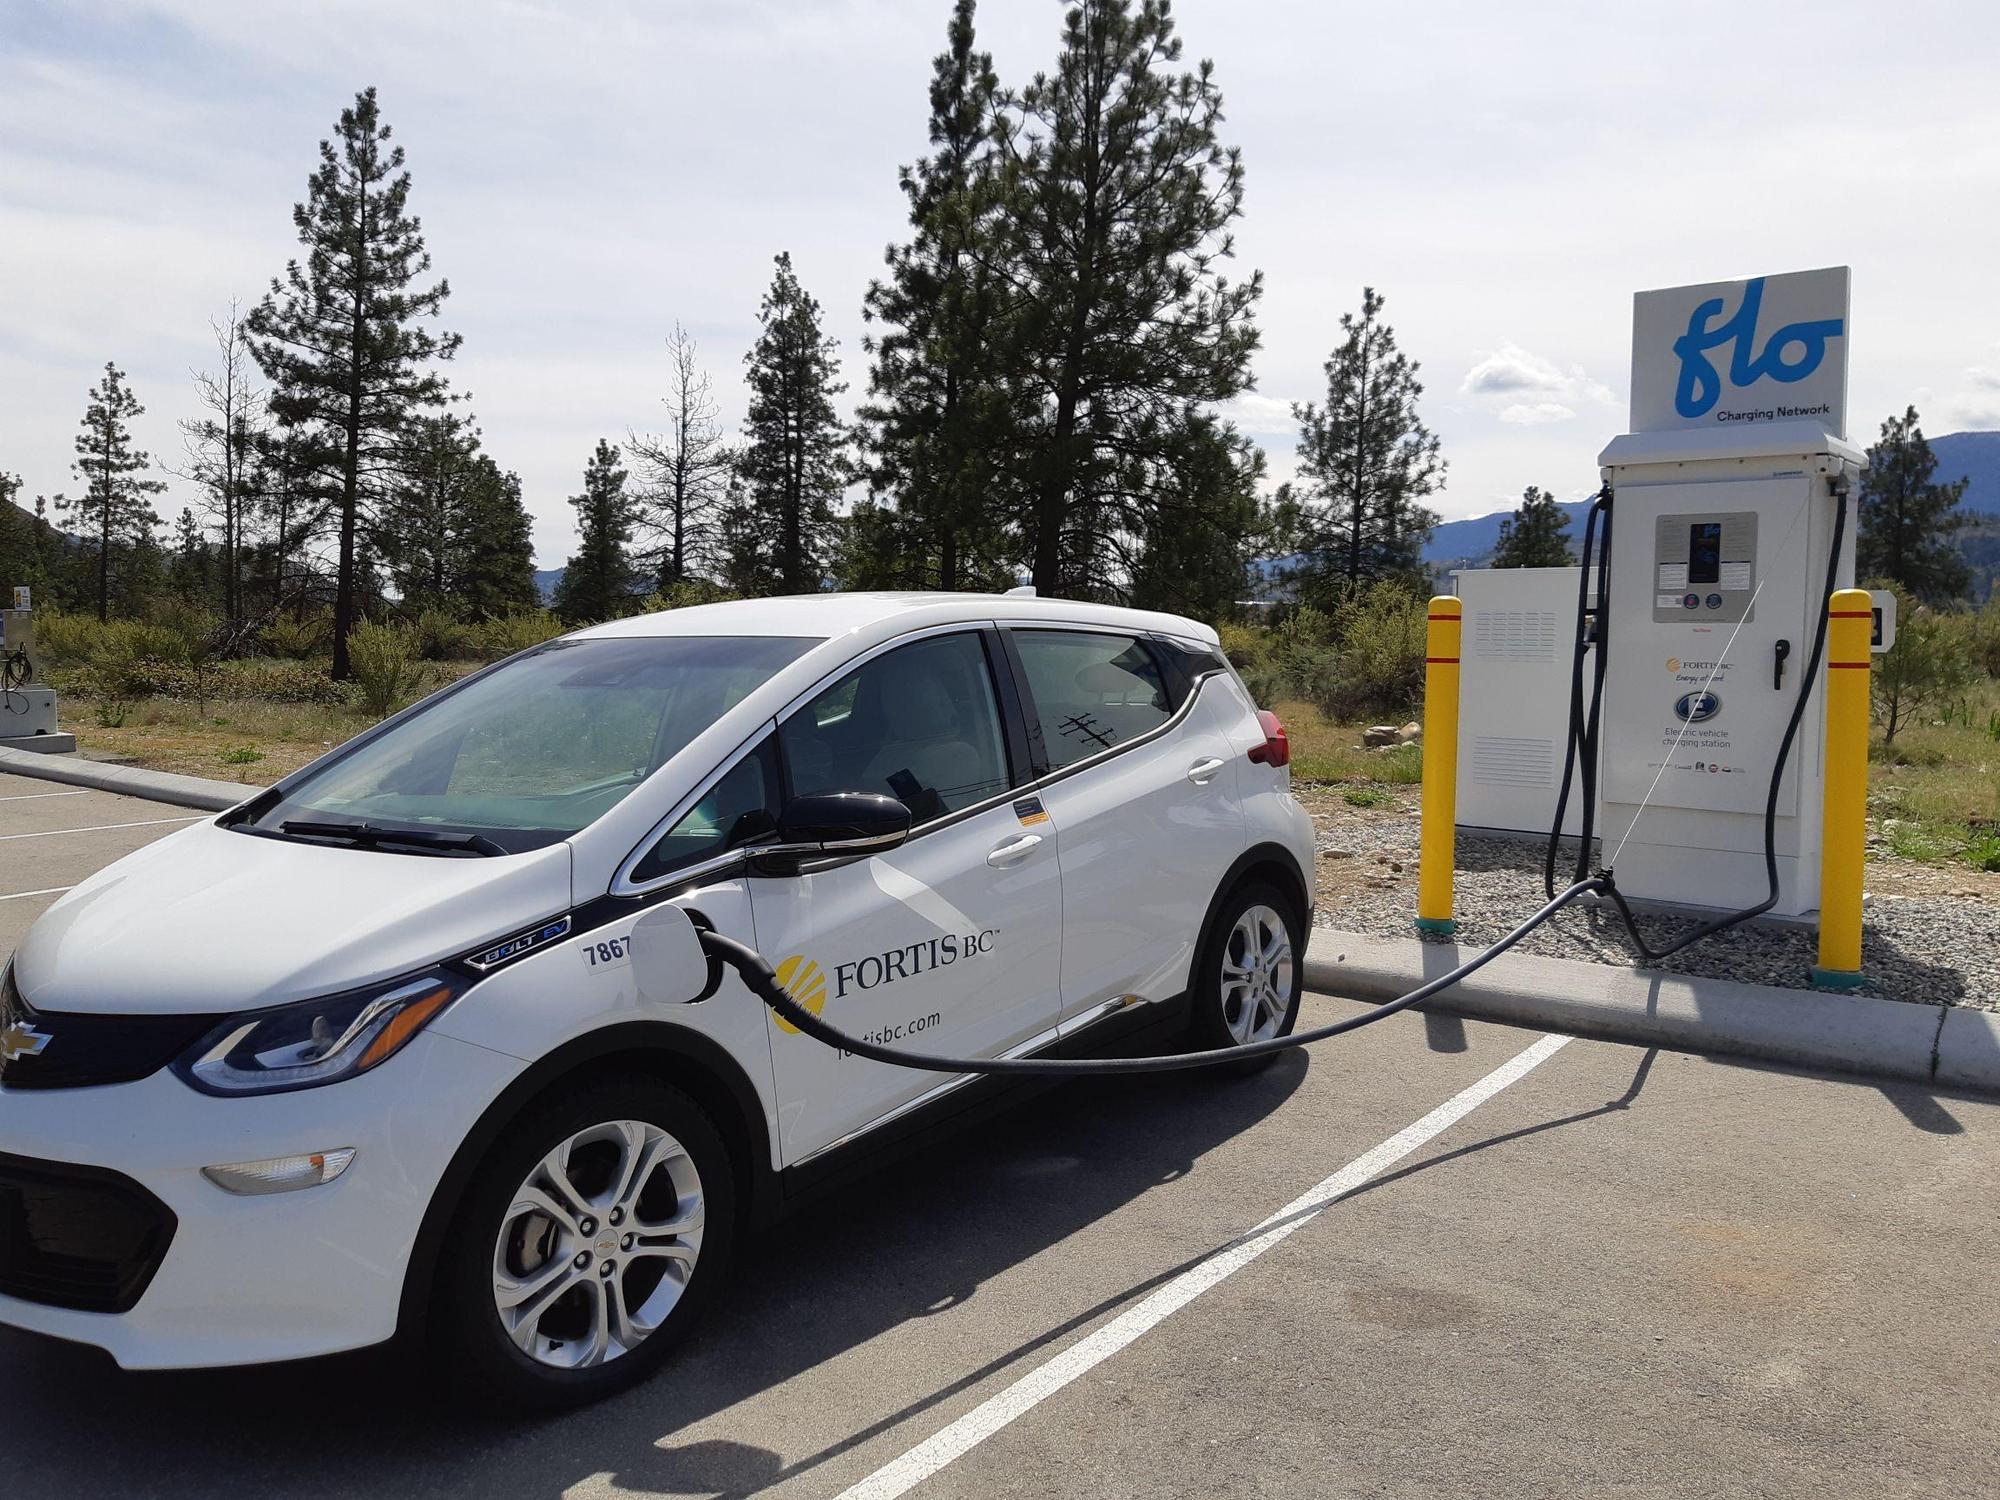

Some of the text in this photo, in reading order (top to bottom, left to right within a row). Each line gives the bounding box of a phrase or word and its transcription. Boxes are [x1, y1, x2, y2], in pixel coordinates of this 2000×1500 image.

[1672, 277, 1844, 419] flo
[1717, 403, 1830, 422] Charging Network
[1699, 729, 1729, 738] vehicle
[1701, 739, 1731, 748] station
[485, 922, 567, 964] BOLT EV
[833, 934, 958, 998] FORTIS
